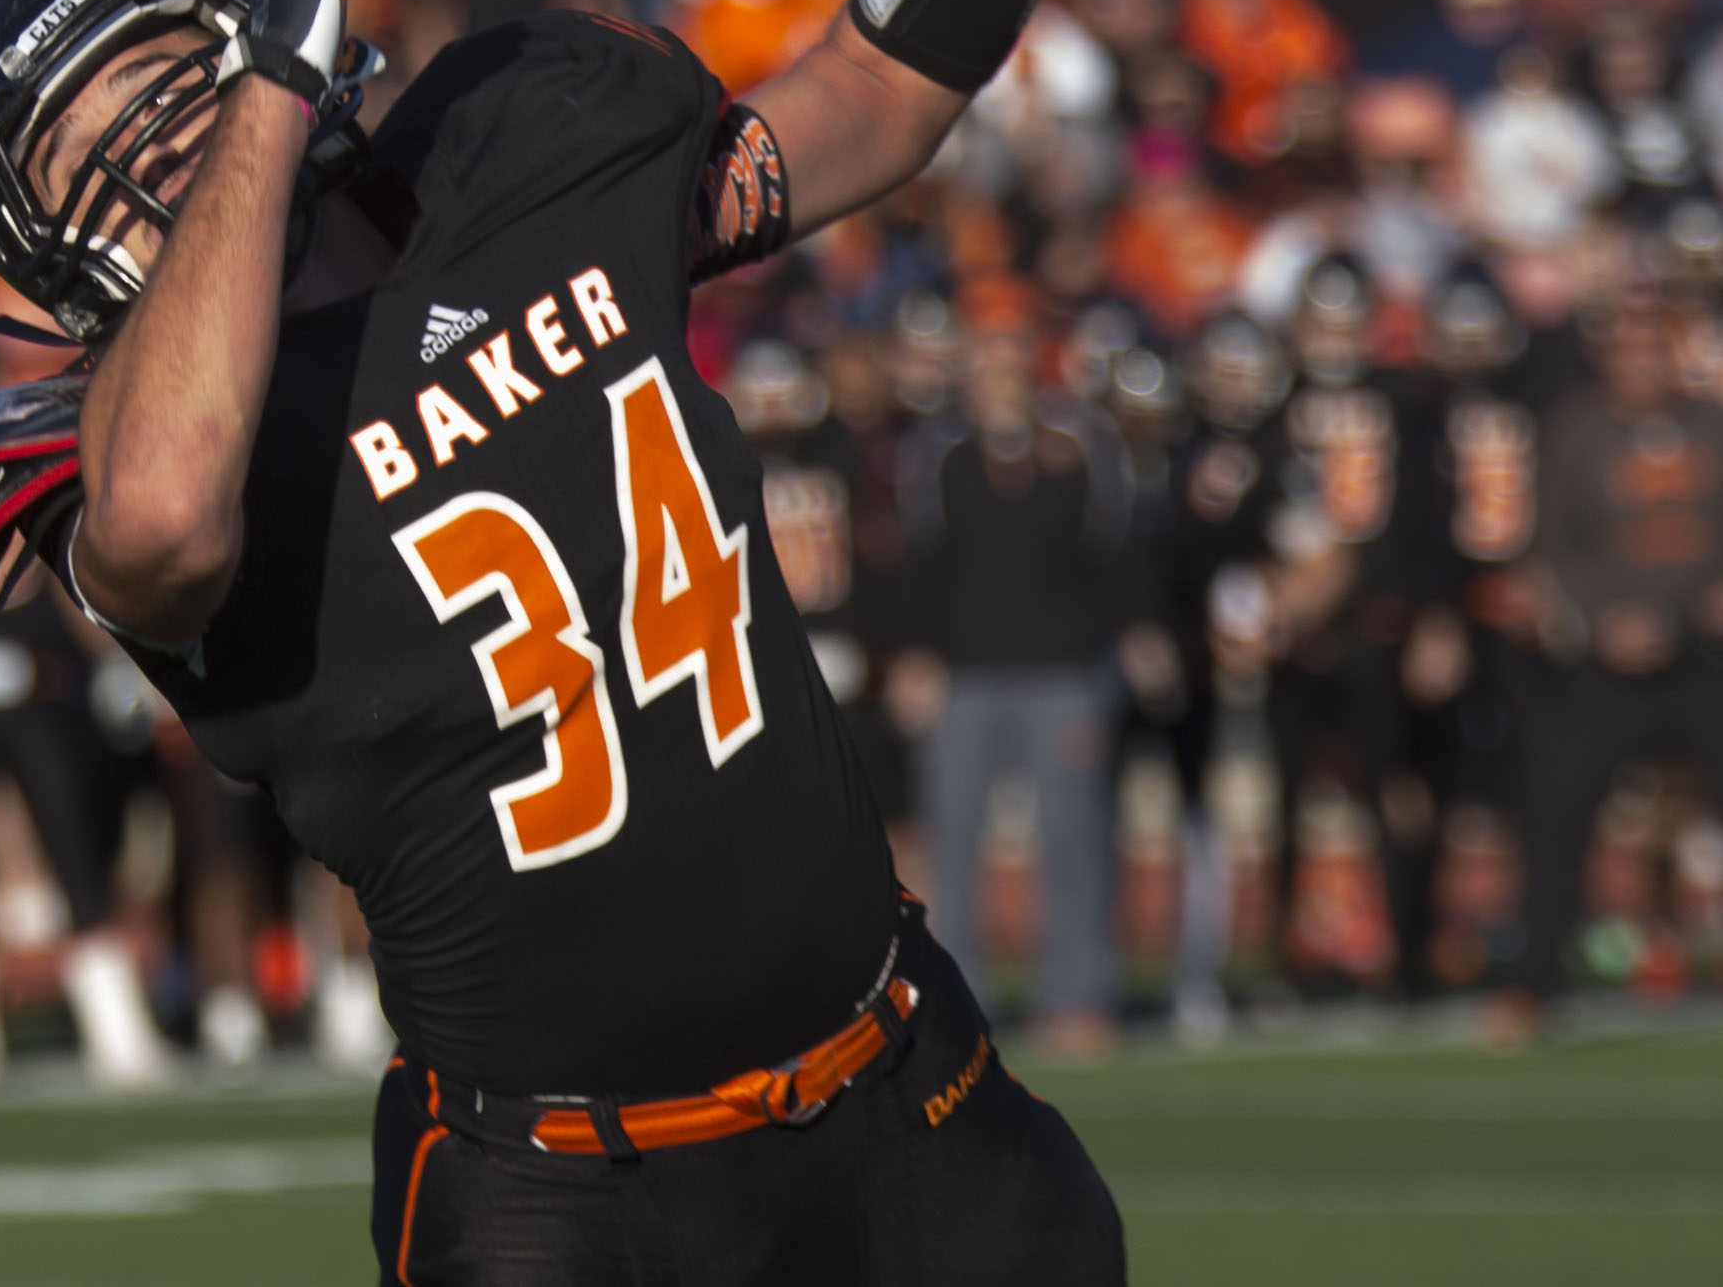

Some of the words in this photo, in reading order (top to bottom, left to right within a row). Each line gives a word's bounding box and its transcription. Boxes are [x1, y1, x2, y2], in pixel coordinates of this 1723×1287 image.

[350, 266, 628, 501] BAKER
[420, 307, 490, 364] adidas
[391, 355, 764, 872] 34
